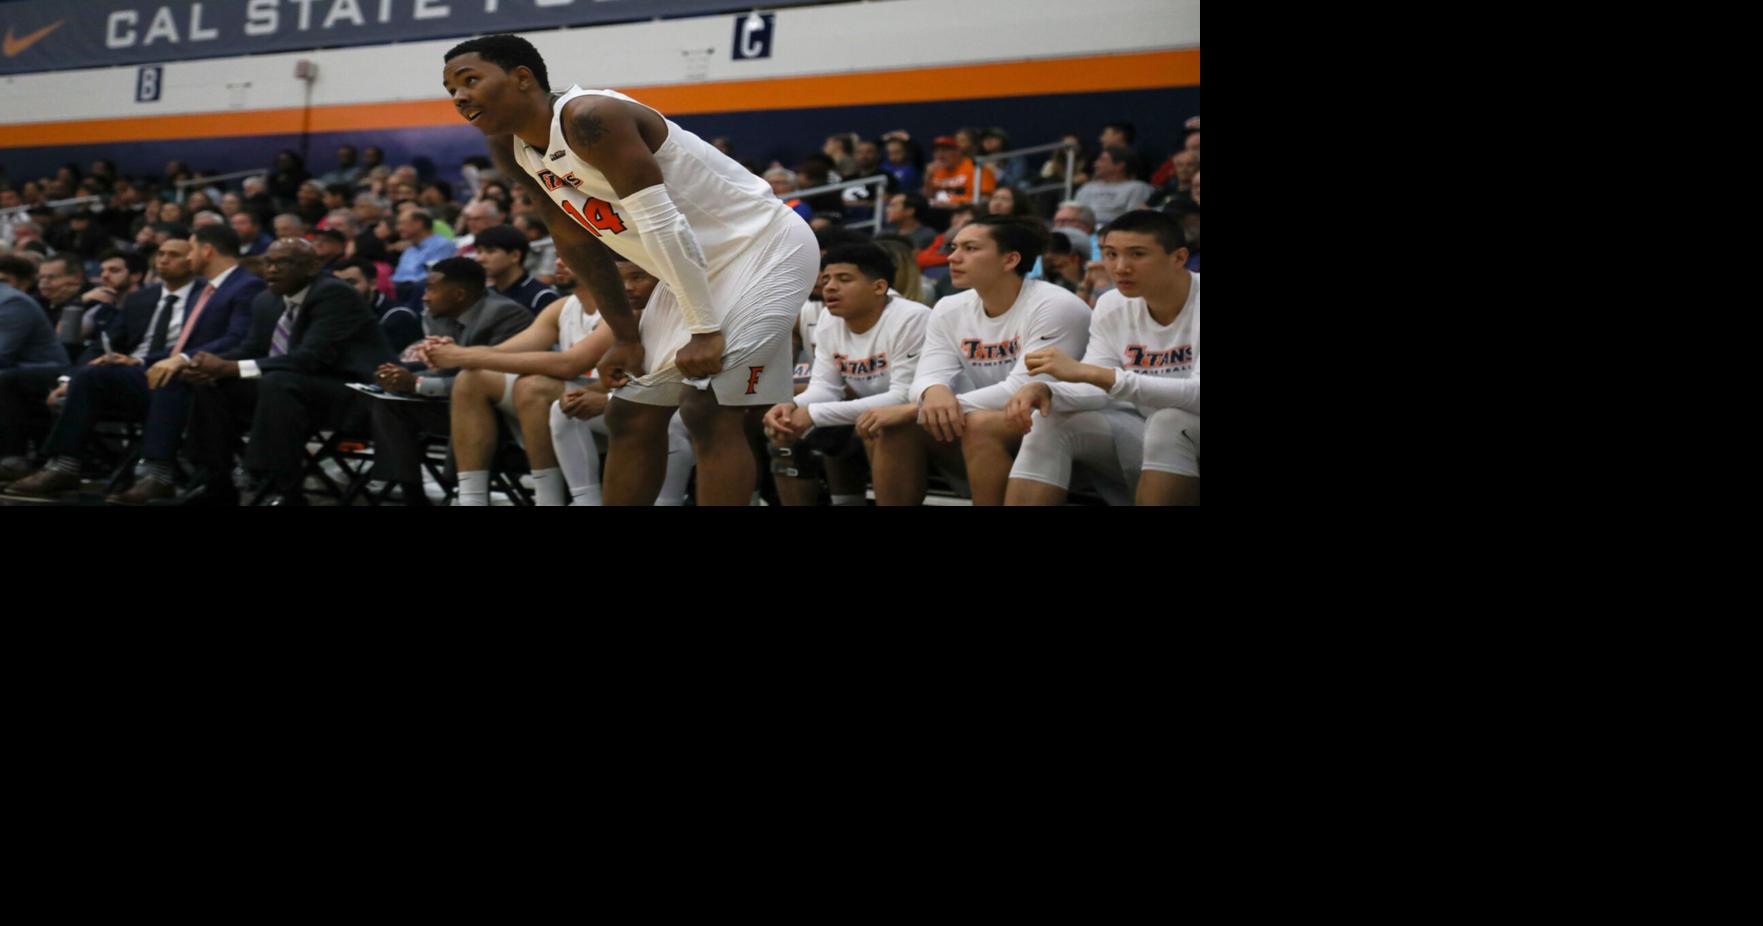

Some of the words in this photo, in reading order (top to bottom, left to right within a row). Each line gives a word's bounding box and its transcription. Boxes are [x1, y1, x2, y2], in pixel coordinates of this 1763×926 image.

[106, 3, 218, 49] CAL
[742, 12, 765, 57] C
[141, 69, 158, 99] B
[562, 197, 627, 237] 14
[744, 365, 765, 395] F
